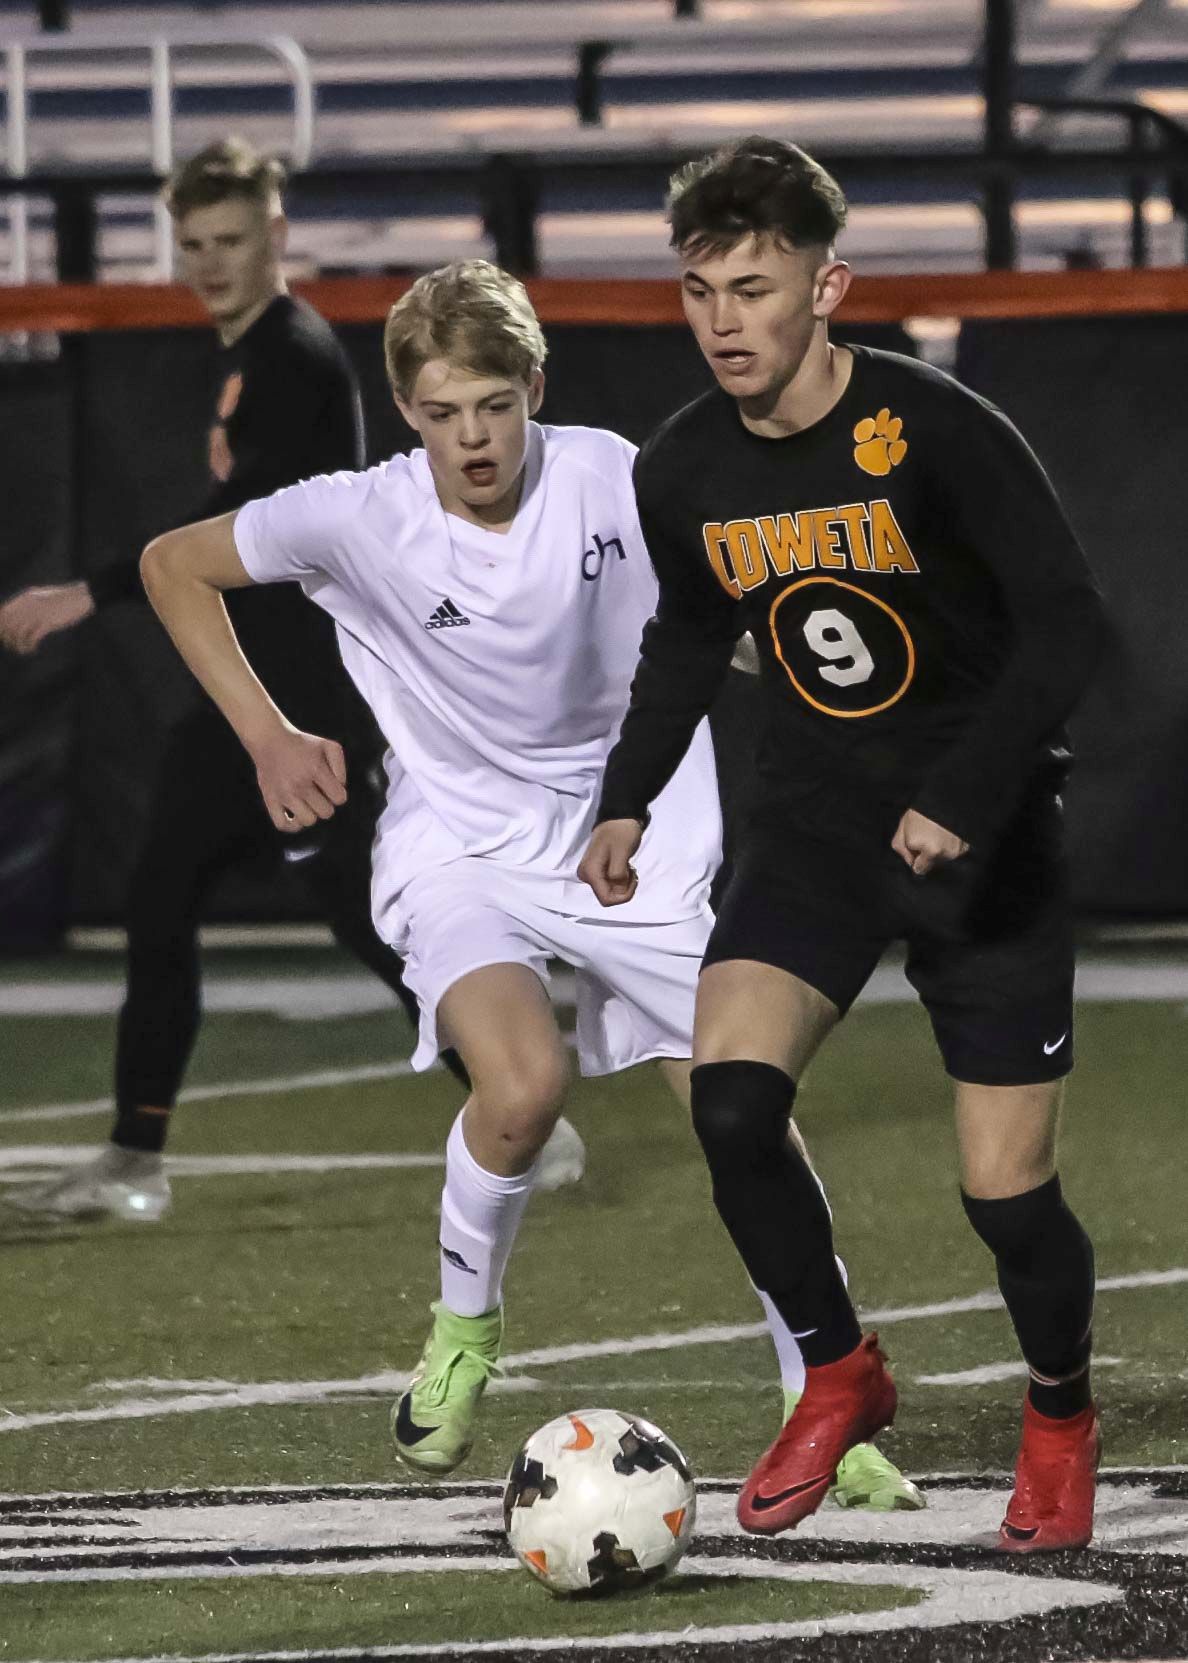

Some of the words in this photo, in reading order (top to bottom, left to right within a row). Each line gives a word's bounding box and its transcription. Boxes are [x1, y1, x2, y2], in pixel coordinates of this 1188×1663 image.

[703, 499, 920, 600] COWETA
[424, 616, 471, 630] adidas
[803, 608, 874, 687] 9
